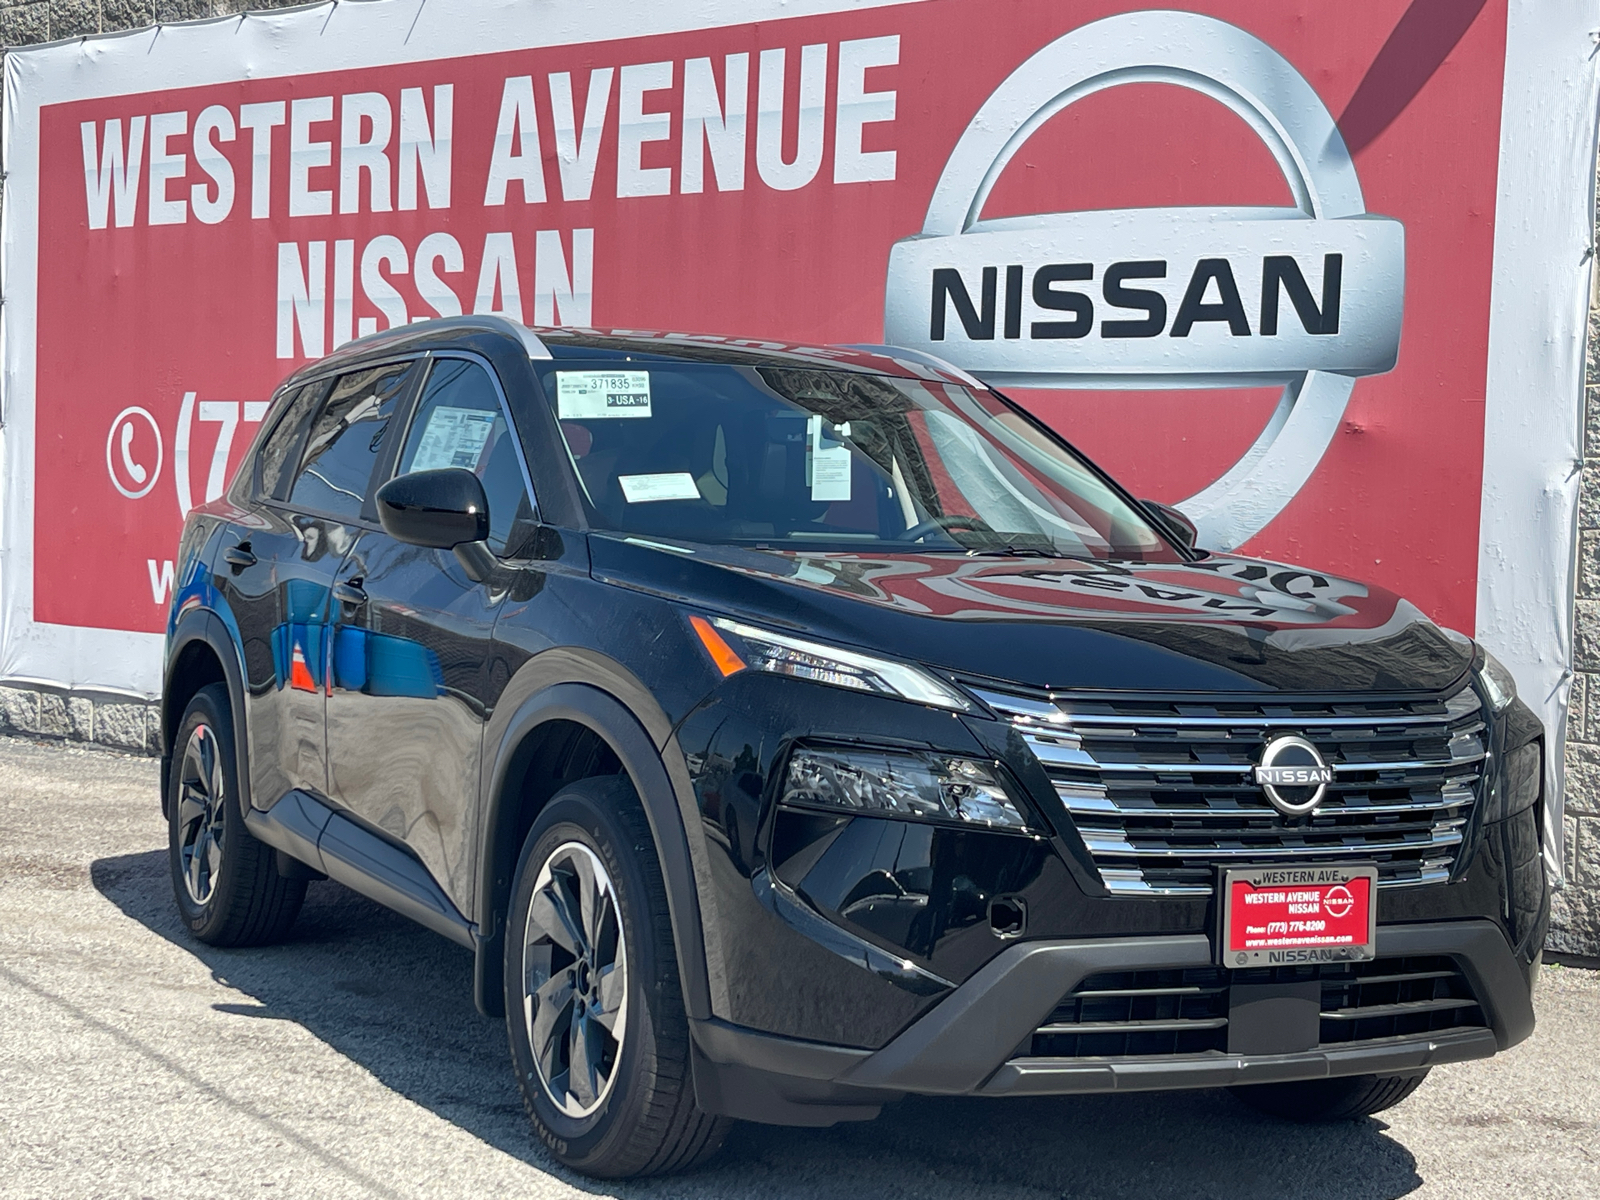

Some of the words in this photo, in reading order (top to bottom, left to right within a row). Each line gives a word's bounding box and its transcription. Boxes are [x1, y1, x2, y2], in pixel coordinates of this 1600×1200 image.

[81, 83, 454, 230] WESTERN
[483, 34, 901, 206] AVENUE
[276, 228, 594, 358] NISSAN
[930, 253, 1342, 341] NISSAN
[591, 379, 630, 389] 371835
[616, 395, 635, 405] USA
[174, 392, 270, 521] (7
[1258, 770, 1331, 782] NISSAN
[1262, 871, 1315, 884] WESTERN
[1244, 892, 1285, 904] WESTERN
[1286, 891, 1320, 903] AVENUE
[1288, 903, 1320, 914] NISSAN
[1267, 921, 1287, 935] (773)
[1289, 920, 1325, 932] 776-8200
[1245, 935, 1353, 947] www.westernavenissan.com
[1268, 949, 1333, 963] NISSAN
